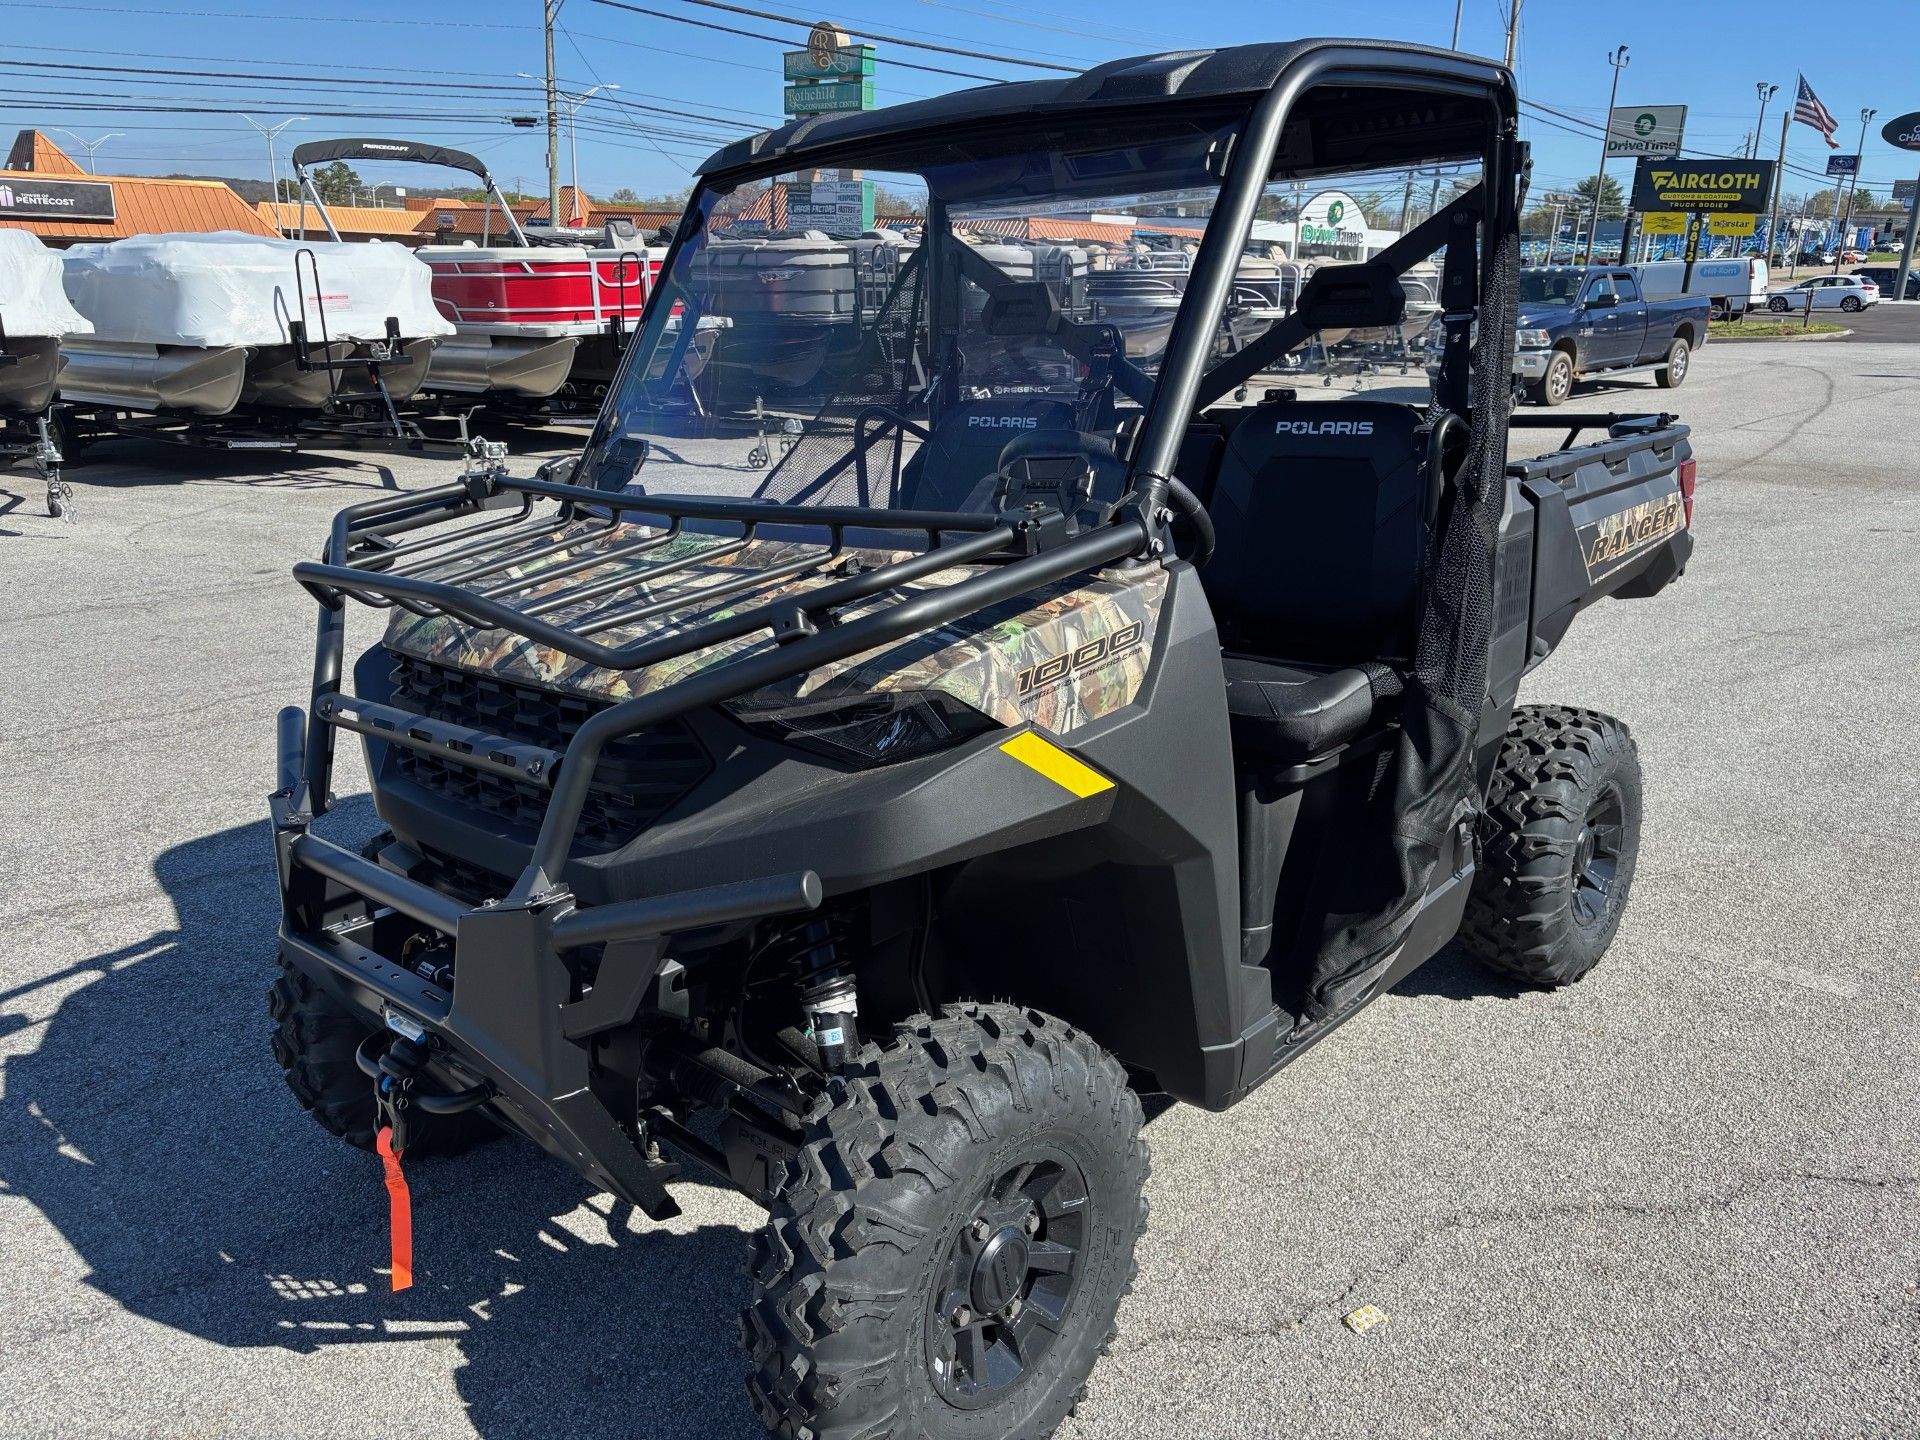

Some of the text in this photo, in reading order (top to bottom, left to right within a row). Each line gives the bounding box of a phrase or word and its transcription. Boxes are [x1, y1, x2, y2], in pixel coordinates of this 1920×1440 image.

[789, 87, 836, 107] Rothchild
[362, 143, 409, 151] PRINCECRAFT
[1607, 139, 1677, 152] DriveTime
[1650, 171, 1760, 191] FAIRCLOTH
[15, 196, 76, 207] PENTECOST
[555, 226, 598, 237] Ranger
[1301, 224, 1364, 244] DriveTime
[1687, 221, 1700, 262] 8812
[1003, 386, 1051, 394] REGENCY
[967, 416, 1038, 429] POLARIS
[1275, 421, 1374, 435] POLARIS
[1586, 502, 1678, 568] RANGER
[1016, 620, 1144, 697] 1000
[1063, 656, 1121, 687] OVERHEAD
[1121, 646, 1143, 661] CAM
